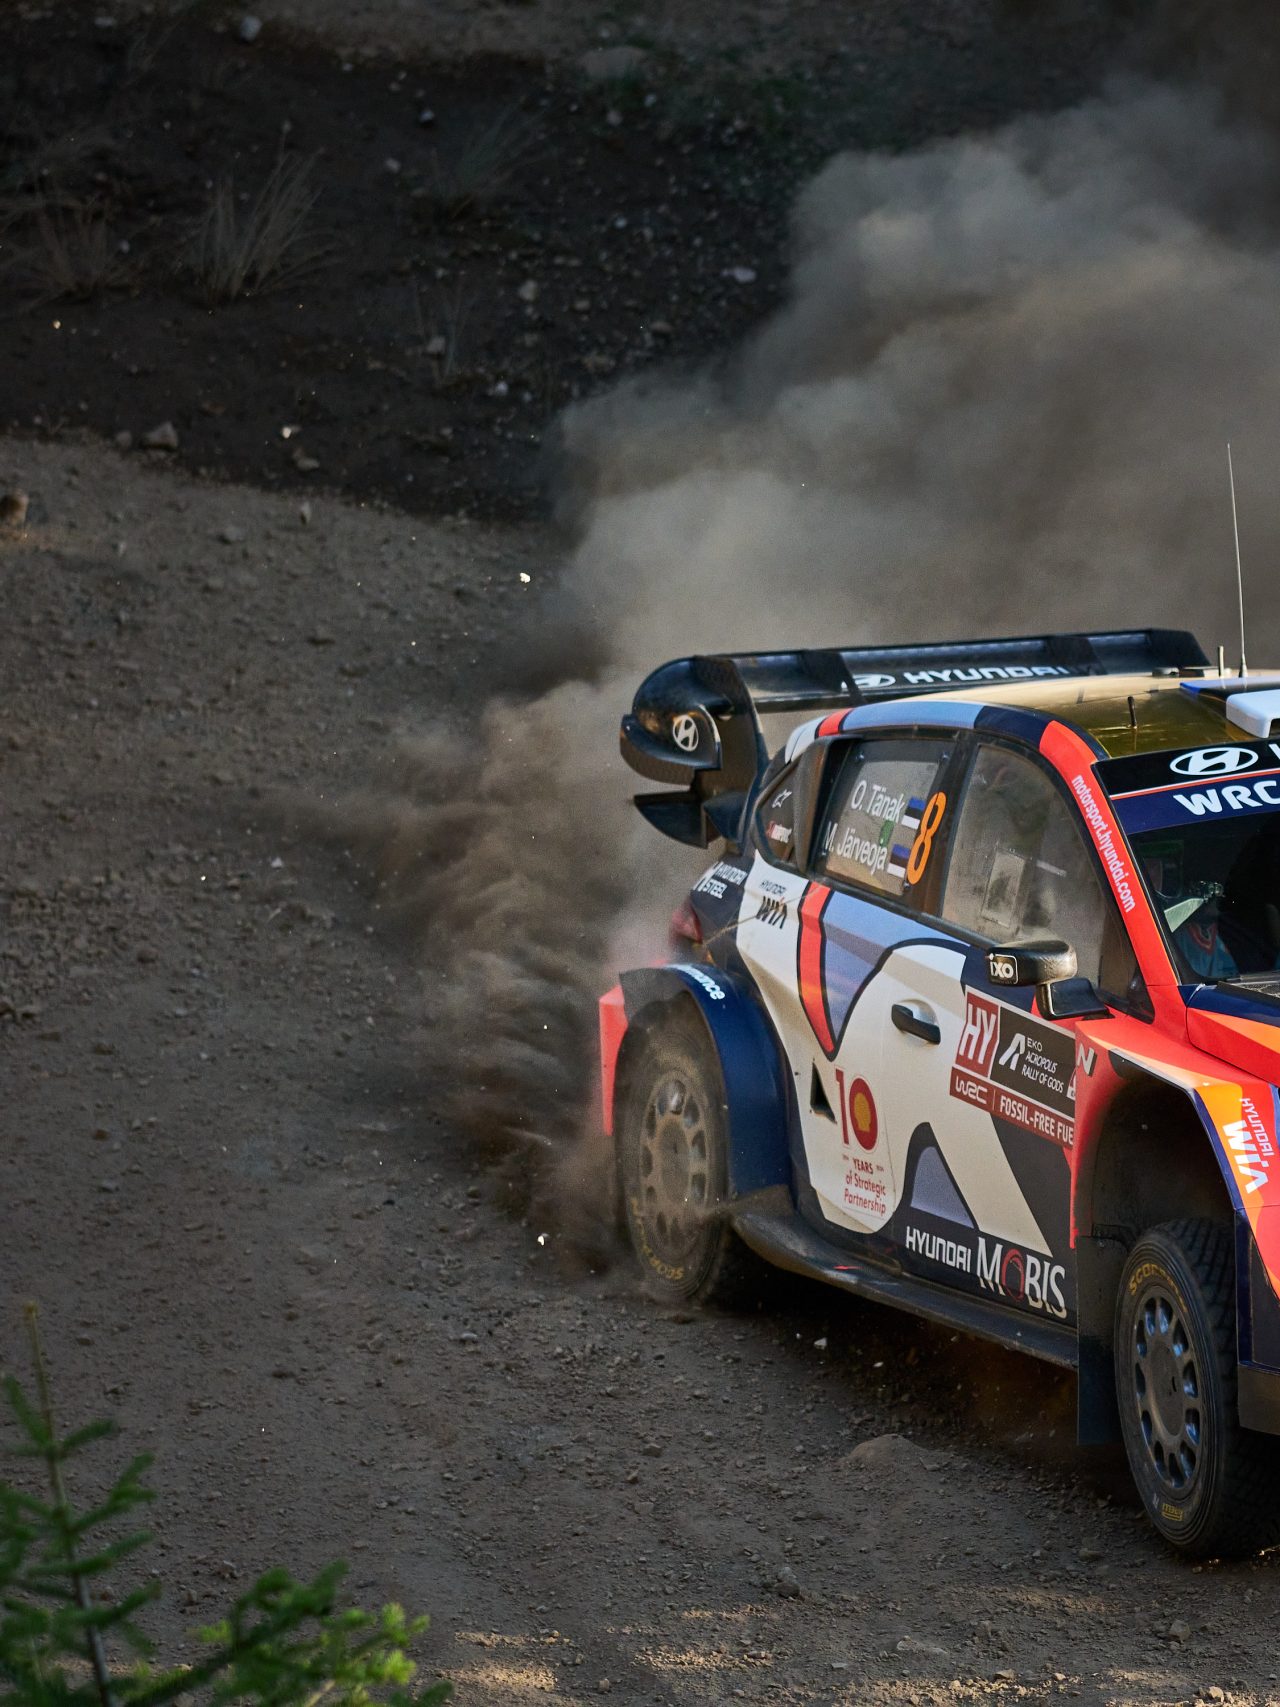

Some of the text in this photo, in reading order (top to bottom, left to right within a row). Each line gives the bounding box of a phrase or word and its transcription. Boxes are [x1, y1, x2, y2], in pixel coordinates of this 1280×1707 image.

[851, 780, 905, 823] O. Tänak
[837, 827, 888, 876] Järveoja
[907, 791, 947, 885] 8
[1071, 774, 1136, 913] motorsport.hyundai.com
[959, 1004, 997, 1065] HY
[1027, 1037, 1043, 1052] EKO
[1021, 1064, 1065, 1094] RALLY OF GODS
[1025, 1052, 1058, 1074] ACROPOLIS
[955, 1076, 988, 1105] WRC
[1000, 1095, 1075, 1145] FOSSIL-FREE FUE
[1240, 1097, 1275, 1157] HYUNDAI
[853, 1157, 873, 1175] YEARS
[1222, 1119, 1269, 1194] WIA
[844, 1188, 887, 1216] Partnership
[845, 1170, 887, 1198] of Strategic
[905, 1225, 1068, 1319] HYUNDAI MOBIS
